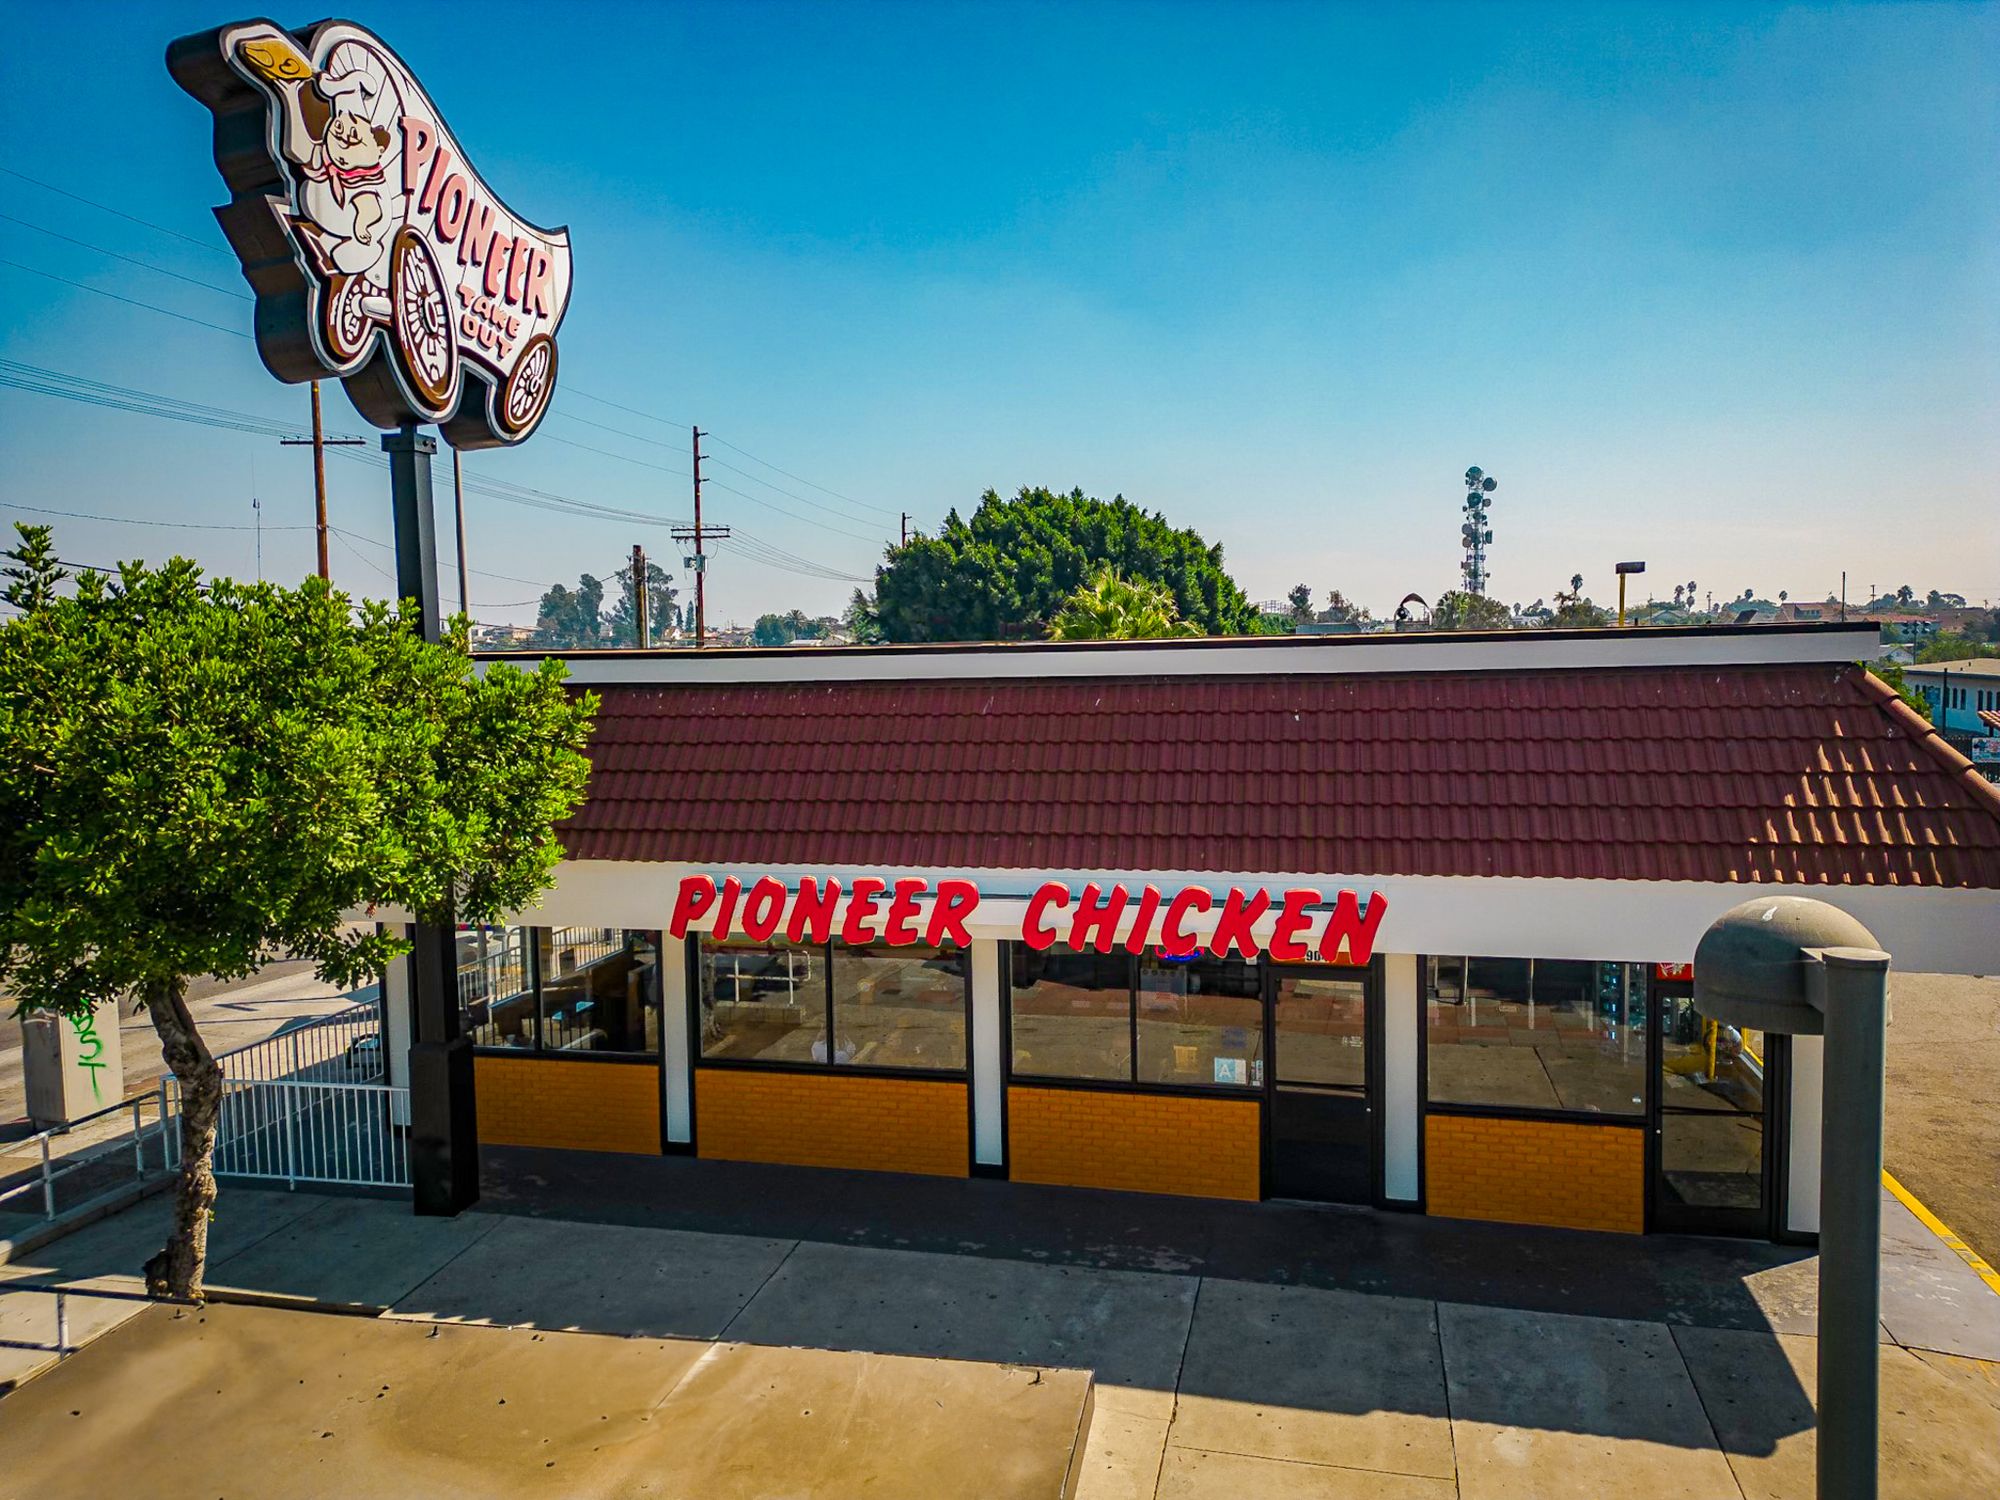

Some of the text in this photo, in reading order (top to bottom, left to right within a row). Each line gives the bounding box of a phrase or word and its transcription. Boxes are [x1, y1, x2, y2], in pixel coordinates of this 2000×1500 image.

[398, 116, 554, 319] PIONEER
[456, 283, 520, 339] TAKE
[459, 313, 513, 361] OUT
[670, 874, 1388, 965] PIONEER CHICKEN
[1219, 1063, 1231, 1078] A
